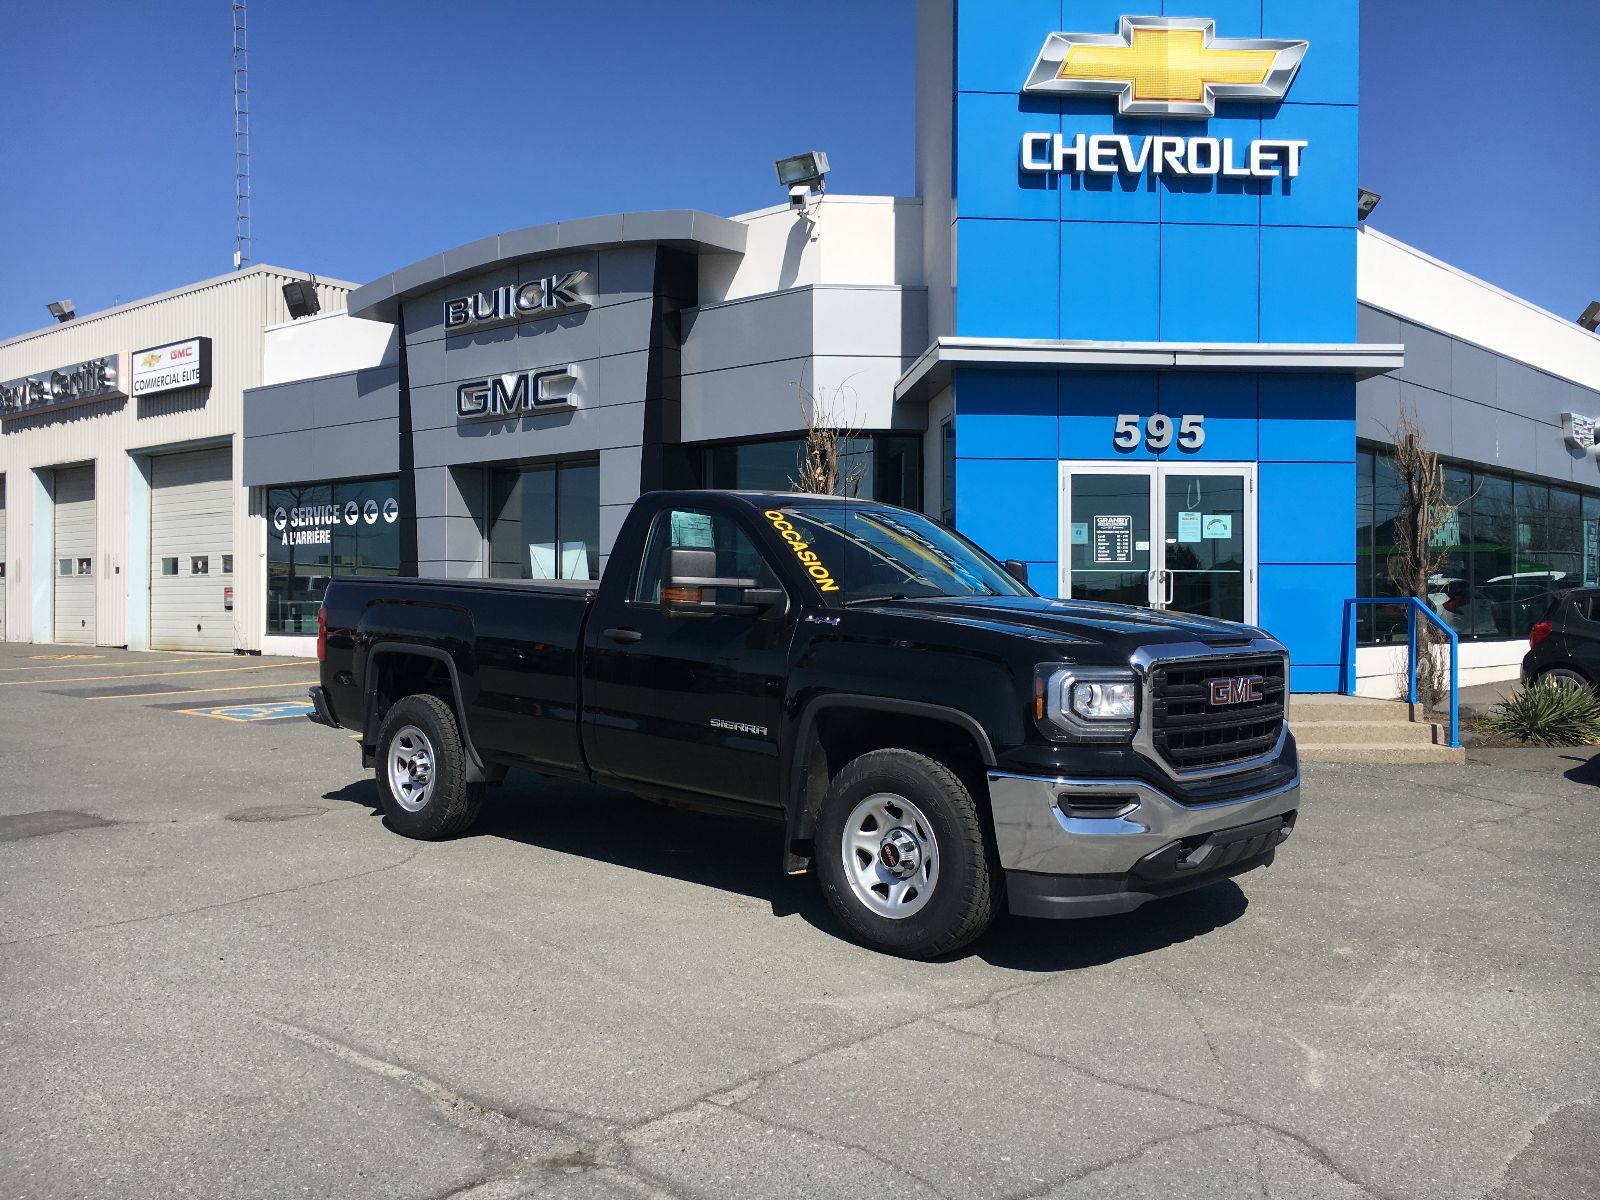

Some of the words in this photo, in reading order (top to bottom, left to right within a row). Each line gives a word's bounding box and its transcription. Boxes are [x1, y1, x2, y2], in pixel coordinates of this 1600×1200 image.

[1020, 132, 1309, 178] CHEVROLET
[443, 269, 592, 332] BUICK
[169, 346, 193, 361] GMC
[134, 371, 181, 392] COMMERCIAL
[182, 367, 200, 383] ÉLITE
[455, 363, 578, 419] GMC
[1114, 413, 1206, 449] 595
[290, 504, 341, 528] SERVICE
[281, 529, 289, 546] À
[289, 526, 331, 546] L'ARRIÈRE
[764, 509, 840, 592] OCCASION
[1210, 674, 1264, 706] GMC
[709, 717, 768, 736] SIERRA
